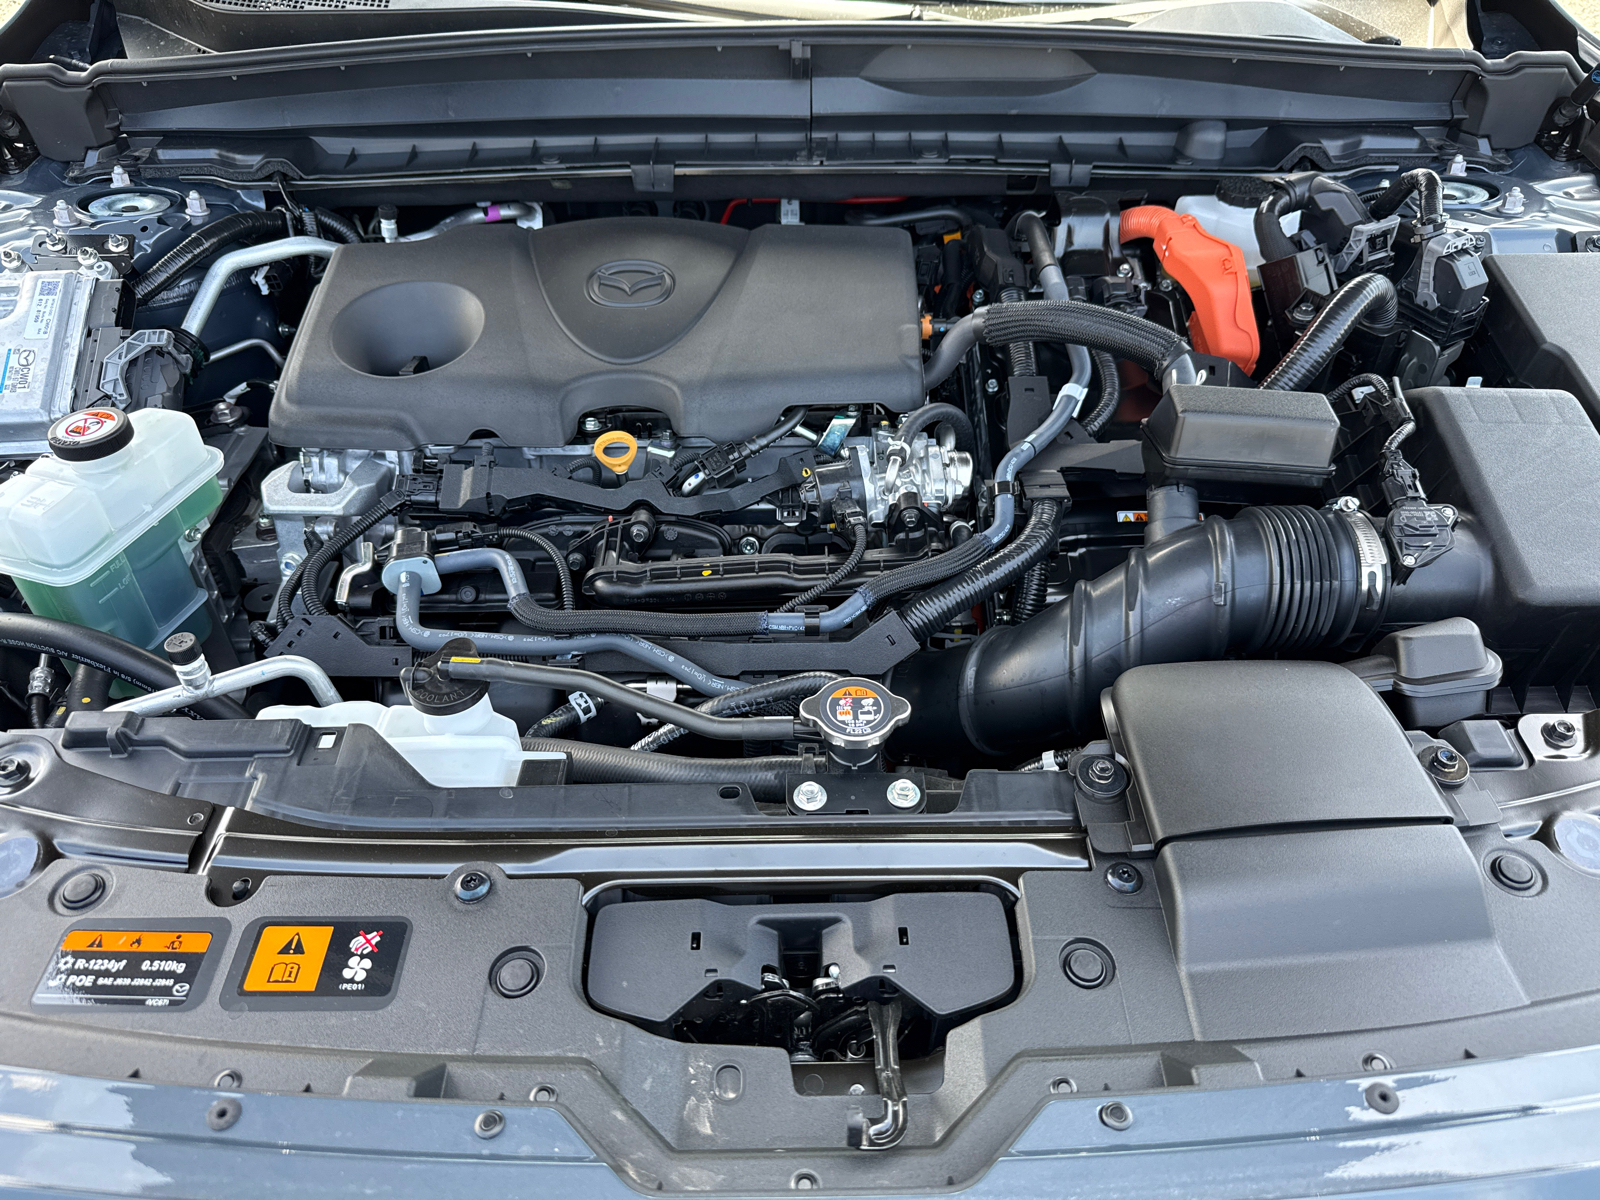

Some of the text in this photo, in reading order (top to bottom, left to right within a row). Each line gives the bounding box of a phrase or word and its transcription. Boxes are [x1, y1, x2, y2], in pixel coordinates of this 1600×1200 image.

[17, 367, 31, 390] CW01
[109, 556, 126, 573] FULL
[413, 687, 466, 703] COOLANT
[74, 959, 186, 973] R-1234yf 0.510kg
[67, 975, 96, 986] POE
[338, 983, 365, 991] (PE01)
